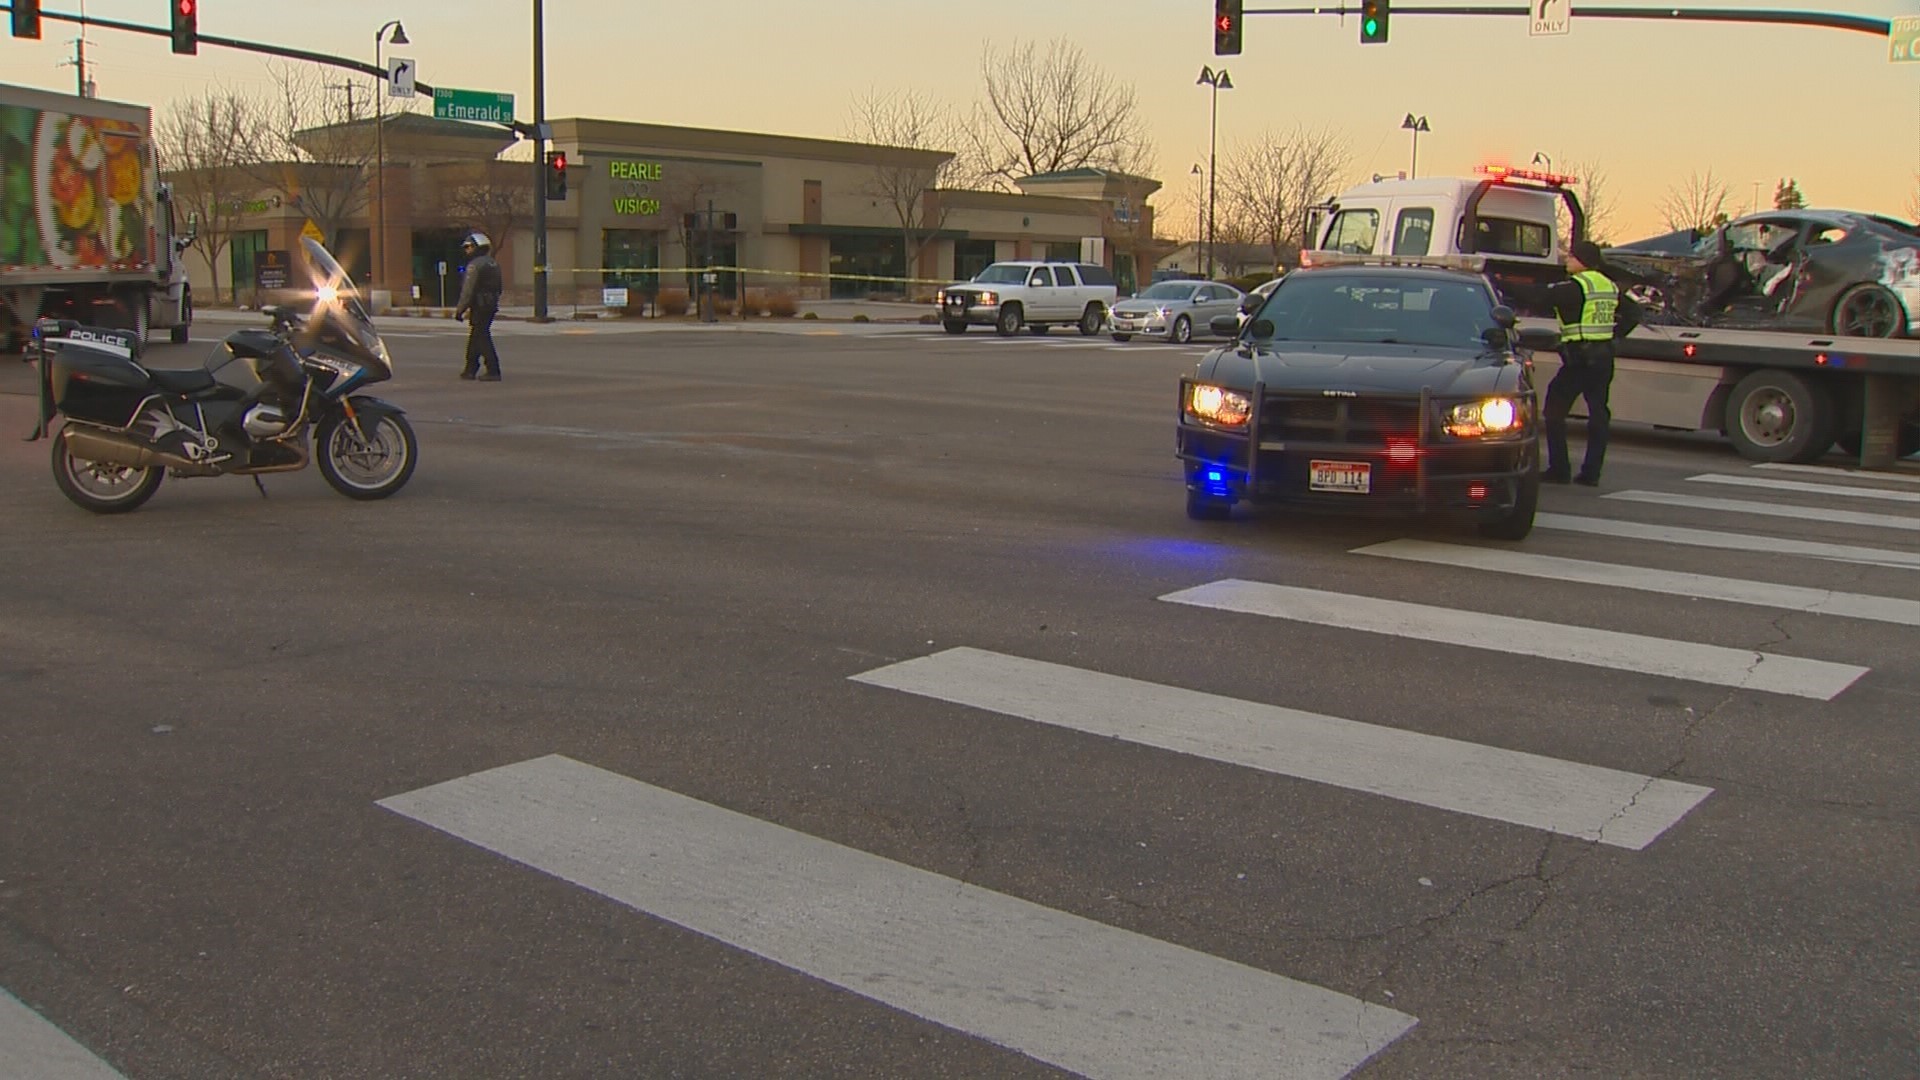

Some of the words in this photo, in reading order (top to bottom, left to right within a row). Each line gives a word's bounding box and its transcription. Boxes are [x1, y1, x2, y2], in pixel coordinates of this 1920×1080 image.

[1535, 21, 1564, 32] ONLY
[392, 86, 412, 95] ONLY
[437, 106, 446, 117] W
[448, 103, 500, 120] Emerald
[610, 161, 662, 180] PEARLE
[614, 199, 660, 215] VISION
[69, 329, 128, 347] POLICE
[1317, 470, 1337, 483] BPD
[1344, 471, 1362, 486] 114
